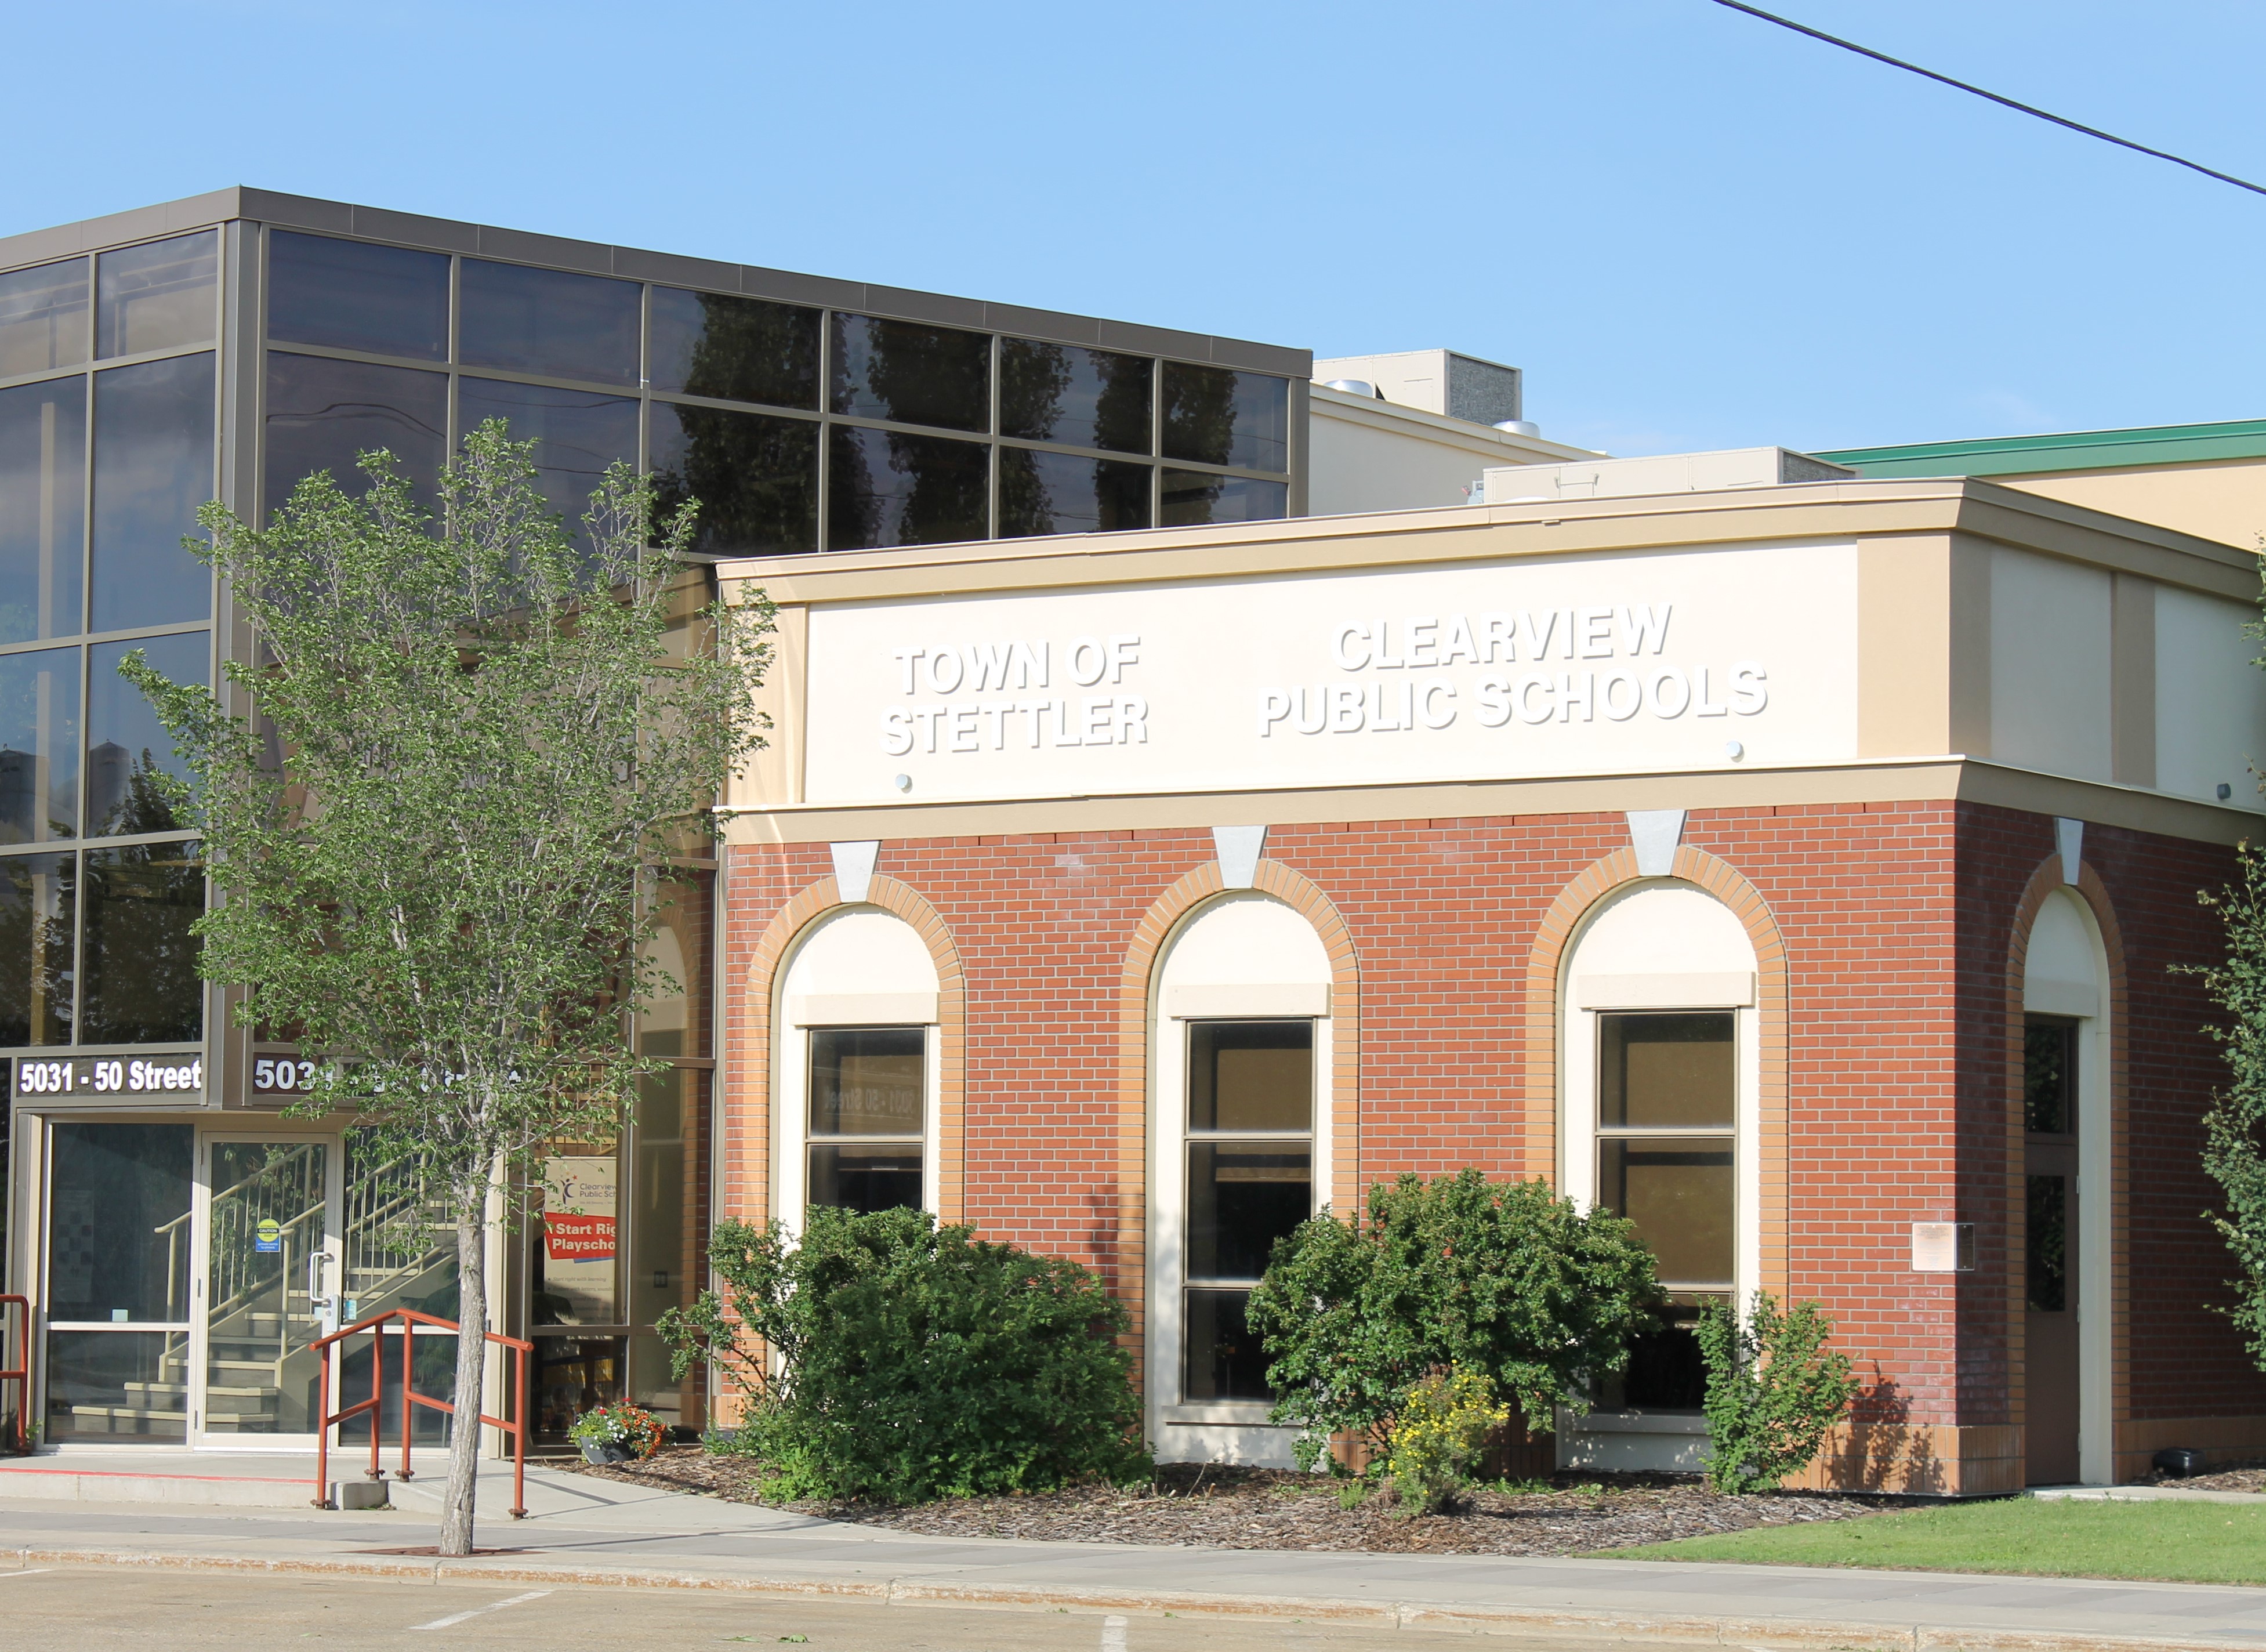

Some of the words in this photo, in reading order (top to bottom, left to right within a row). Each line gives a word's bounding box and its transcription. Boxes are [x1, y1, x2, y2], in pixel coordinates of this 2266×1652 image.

[891, 639, 1049, 695] TOWN
[1064, 633, 1141, 687] OF
[1330, 601, 1673, 672] CLEARVIEW
[879, 694, 1149, 757] STETTLER
[1257, 677, 1458, 738] PUBLIC
[1473, 660, 1768, 728] SCHOOLS
[20, 1062, 74, 1093] 5031
[79, 1075, 90, 1085] -
[94, 1060, 124, 1092] 50
[128, 1059, 201, 1091] Street
[556, 1222, 592, 1235] Start
